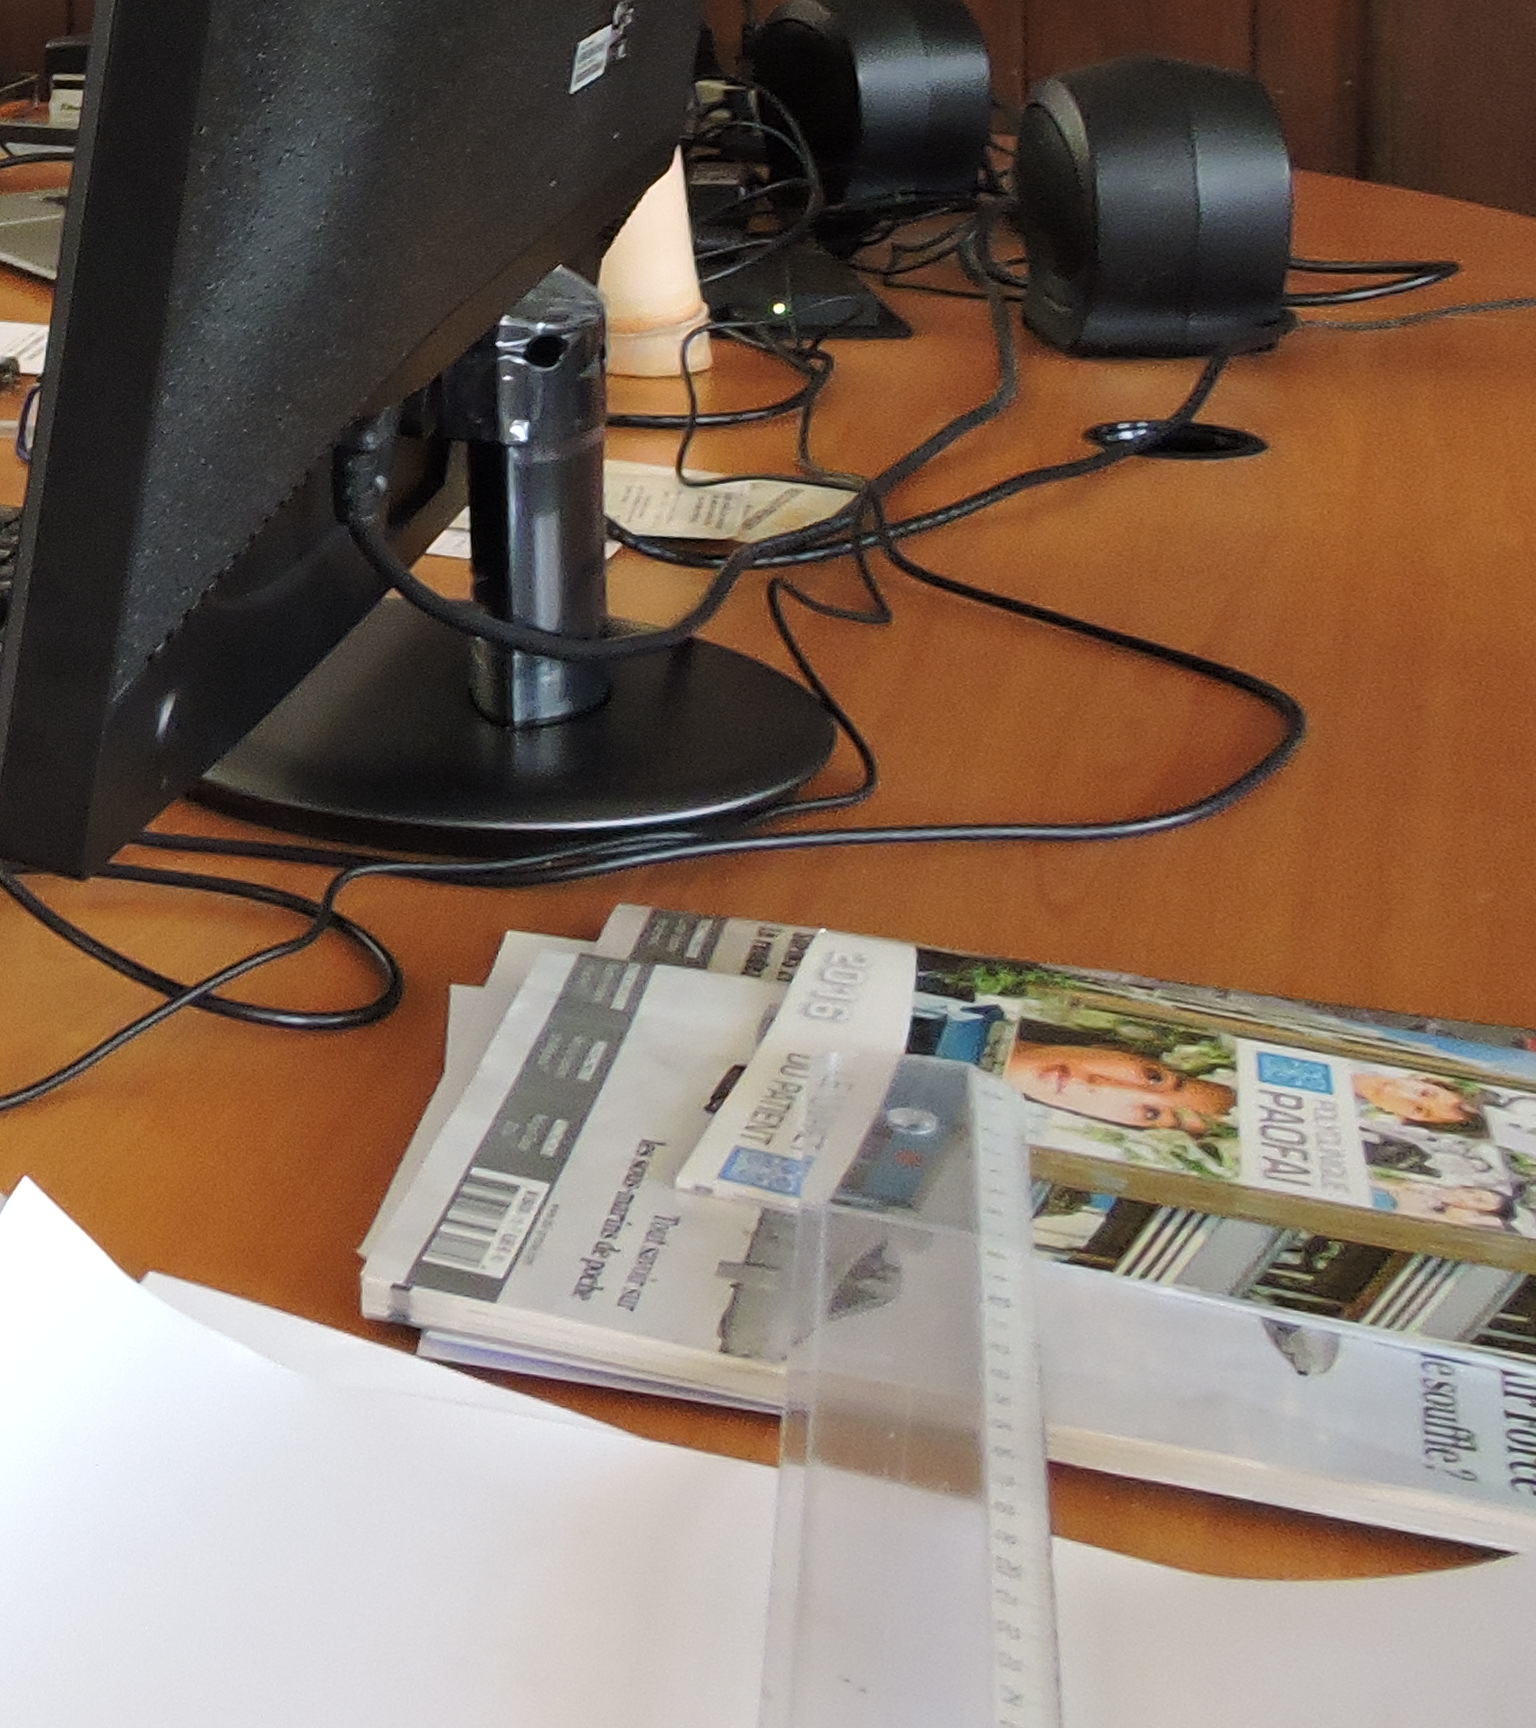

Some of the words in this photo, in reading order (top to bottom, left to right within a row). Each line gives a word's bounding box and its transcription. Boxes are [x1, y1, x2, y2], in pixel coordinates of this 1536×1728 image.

[740, 1080, 804, 1146] PATIENT
[1257, 1089, 1311, 1186] PAOFAI
[1423, 1378, 1478, 1462] souffle
